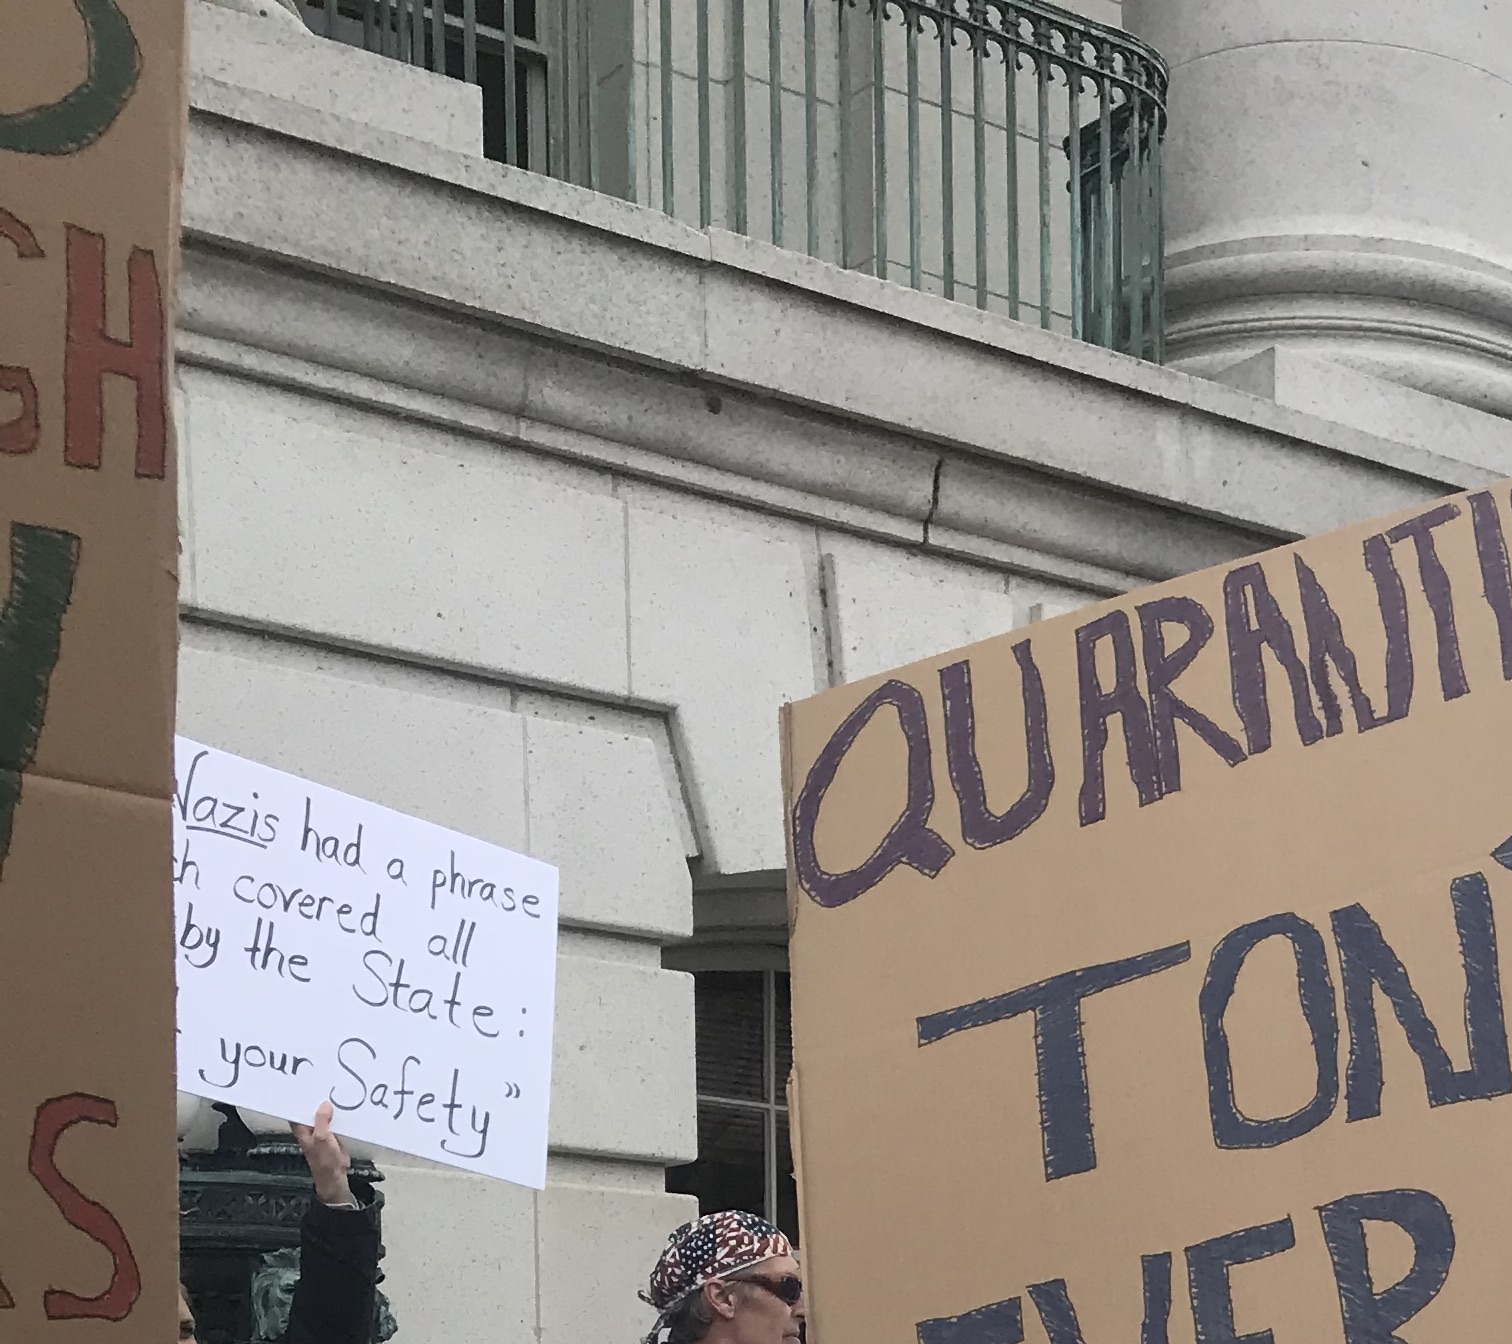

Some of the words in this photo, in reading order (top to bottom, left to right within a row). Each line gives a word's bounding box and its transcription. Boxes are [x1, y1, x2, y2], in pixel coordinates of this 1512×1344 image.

[300, 795, 367, 876] had
[386, 855, 408, 887] a
[430, 848, 542, 919] phrase
[179, 901, 221, 969] by
[243, 916, 312, 983] the
[232, 873, 383, 949] covered
[426, 918, 476, 968] all
[198, 1036, 315, 1089] your
